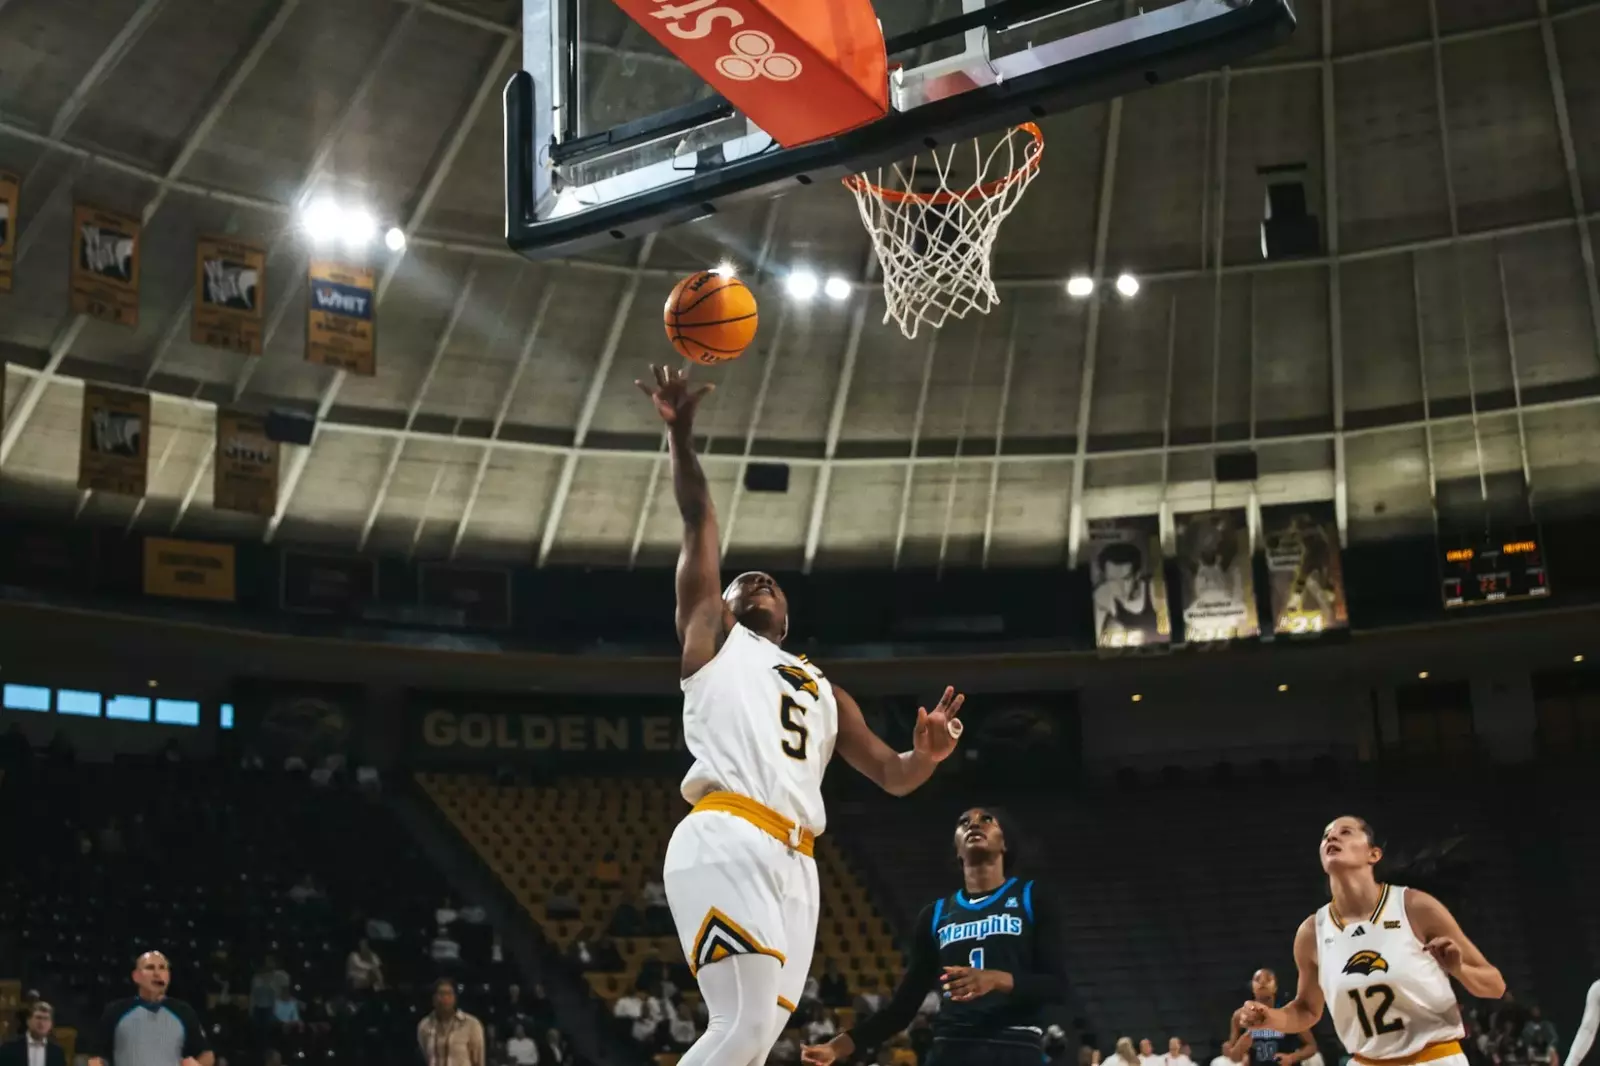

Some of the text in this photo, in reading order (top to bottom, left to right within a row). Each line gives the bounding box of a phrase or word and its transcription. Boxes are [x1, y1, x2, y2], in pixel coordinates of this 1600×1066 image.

[423, 710, 684, 751] GOLDEN E
[780, 693, 809, 761] 5
[937, 913, 1022, 950] Memphis
[968, 947, 985, 971] 1
[1348, 984, 1405, 1038] 12
